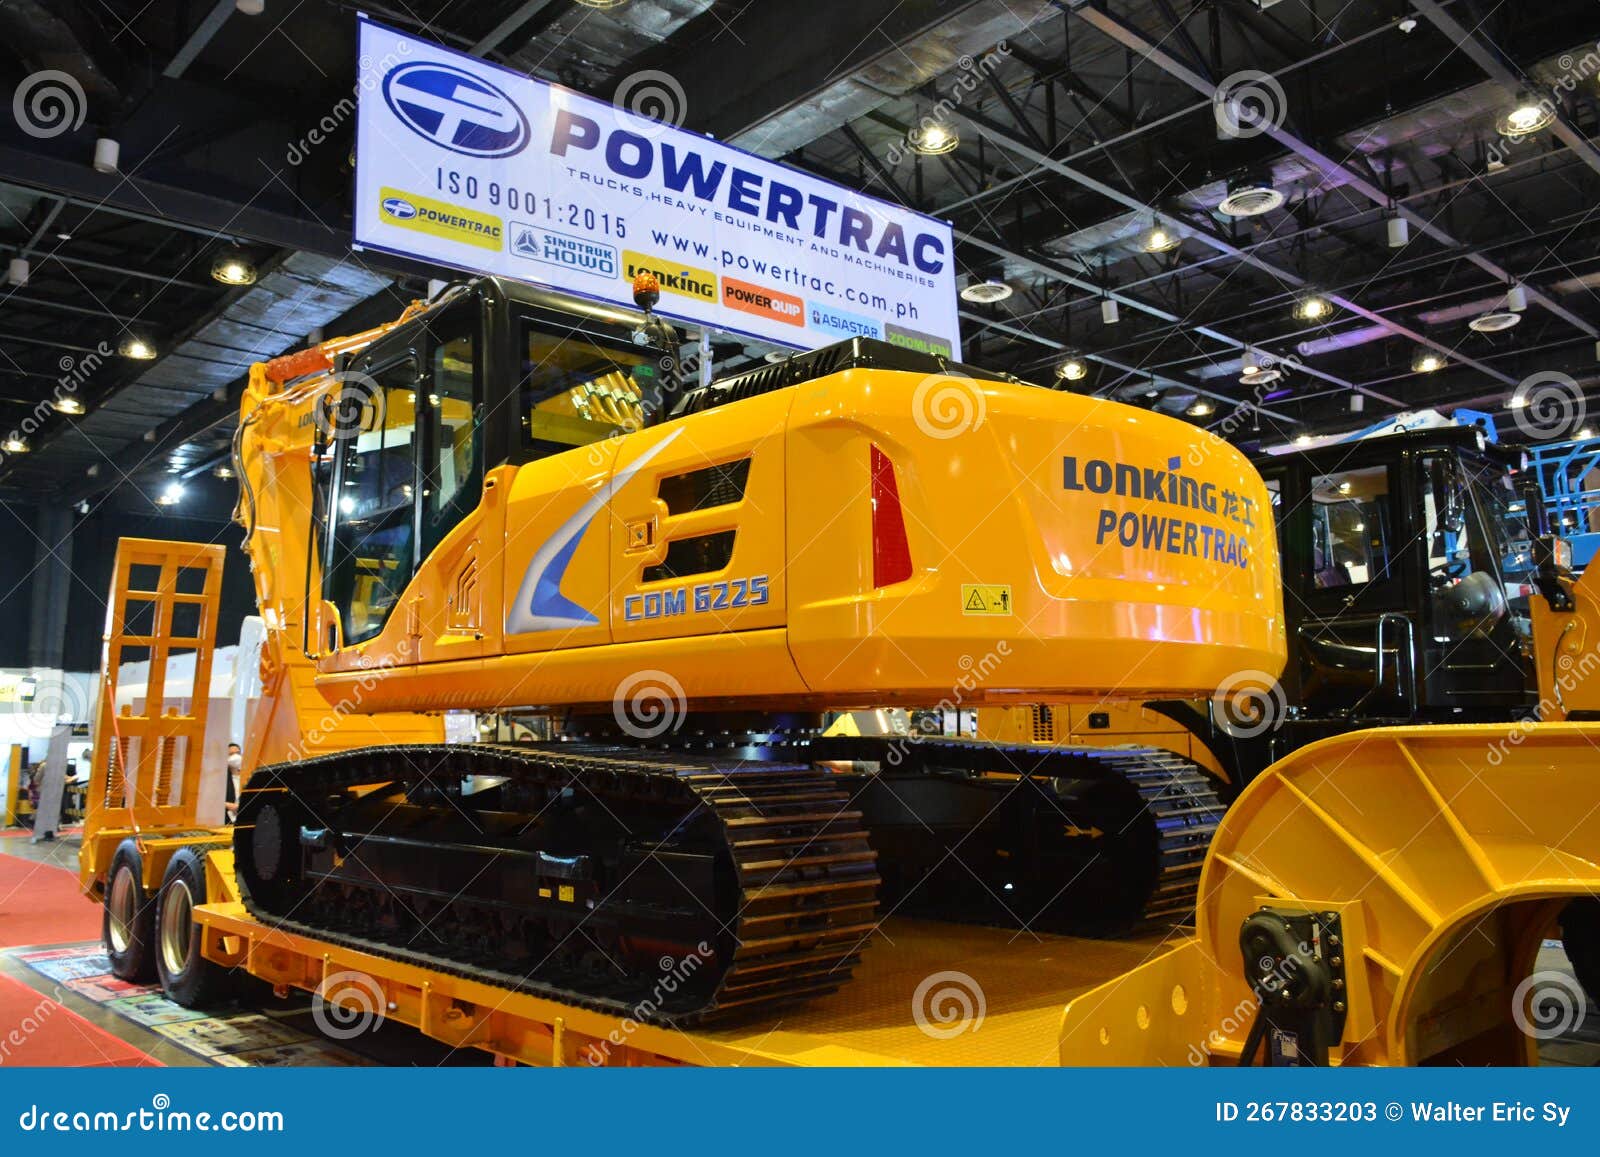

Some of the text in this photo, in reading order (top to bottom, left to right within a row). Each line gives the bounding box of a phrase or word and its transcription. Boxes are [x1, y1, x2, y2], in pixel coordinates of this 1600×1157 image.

[437, 167, 478, 199] ISO
[489, 183, 626, 238] 9001:2015
[550, 109, 945, 275] POWERTRAC
[418, 208, 501, 237] POWERTRAC
[544, 234, 612, 259] SINOTRUK
[544, 246, 613, 273] HOWO
[714, 212, 804, 246] EQUIPMENT
[811, 243, 839, 258] AND
[844, 255, 935, 288] MACHINERIES
[652, 230, 918, 319] www.powertrac.com.ph
[726, 286, 801, 316] POWERQUIP
[822, 314, 878, 338] ASIASTAR
[1221, 488, 1255, 528] 龙工
[1096, 509, 1248, 569] POWERTRAC
[624, 574, 768, 621] CDM 6225
